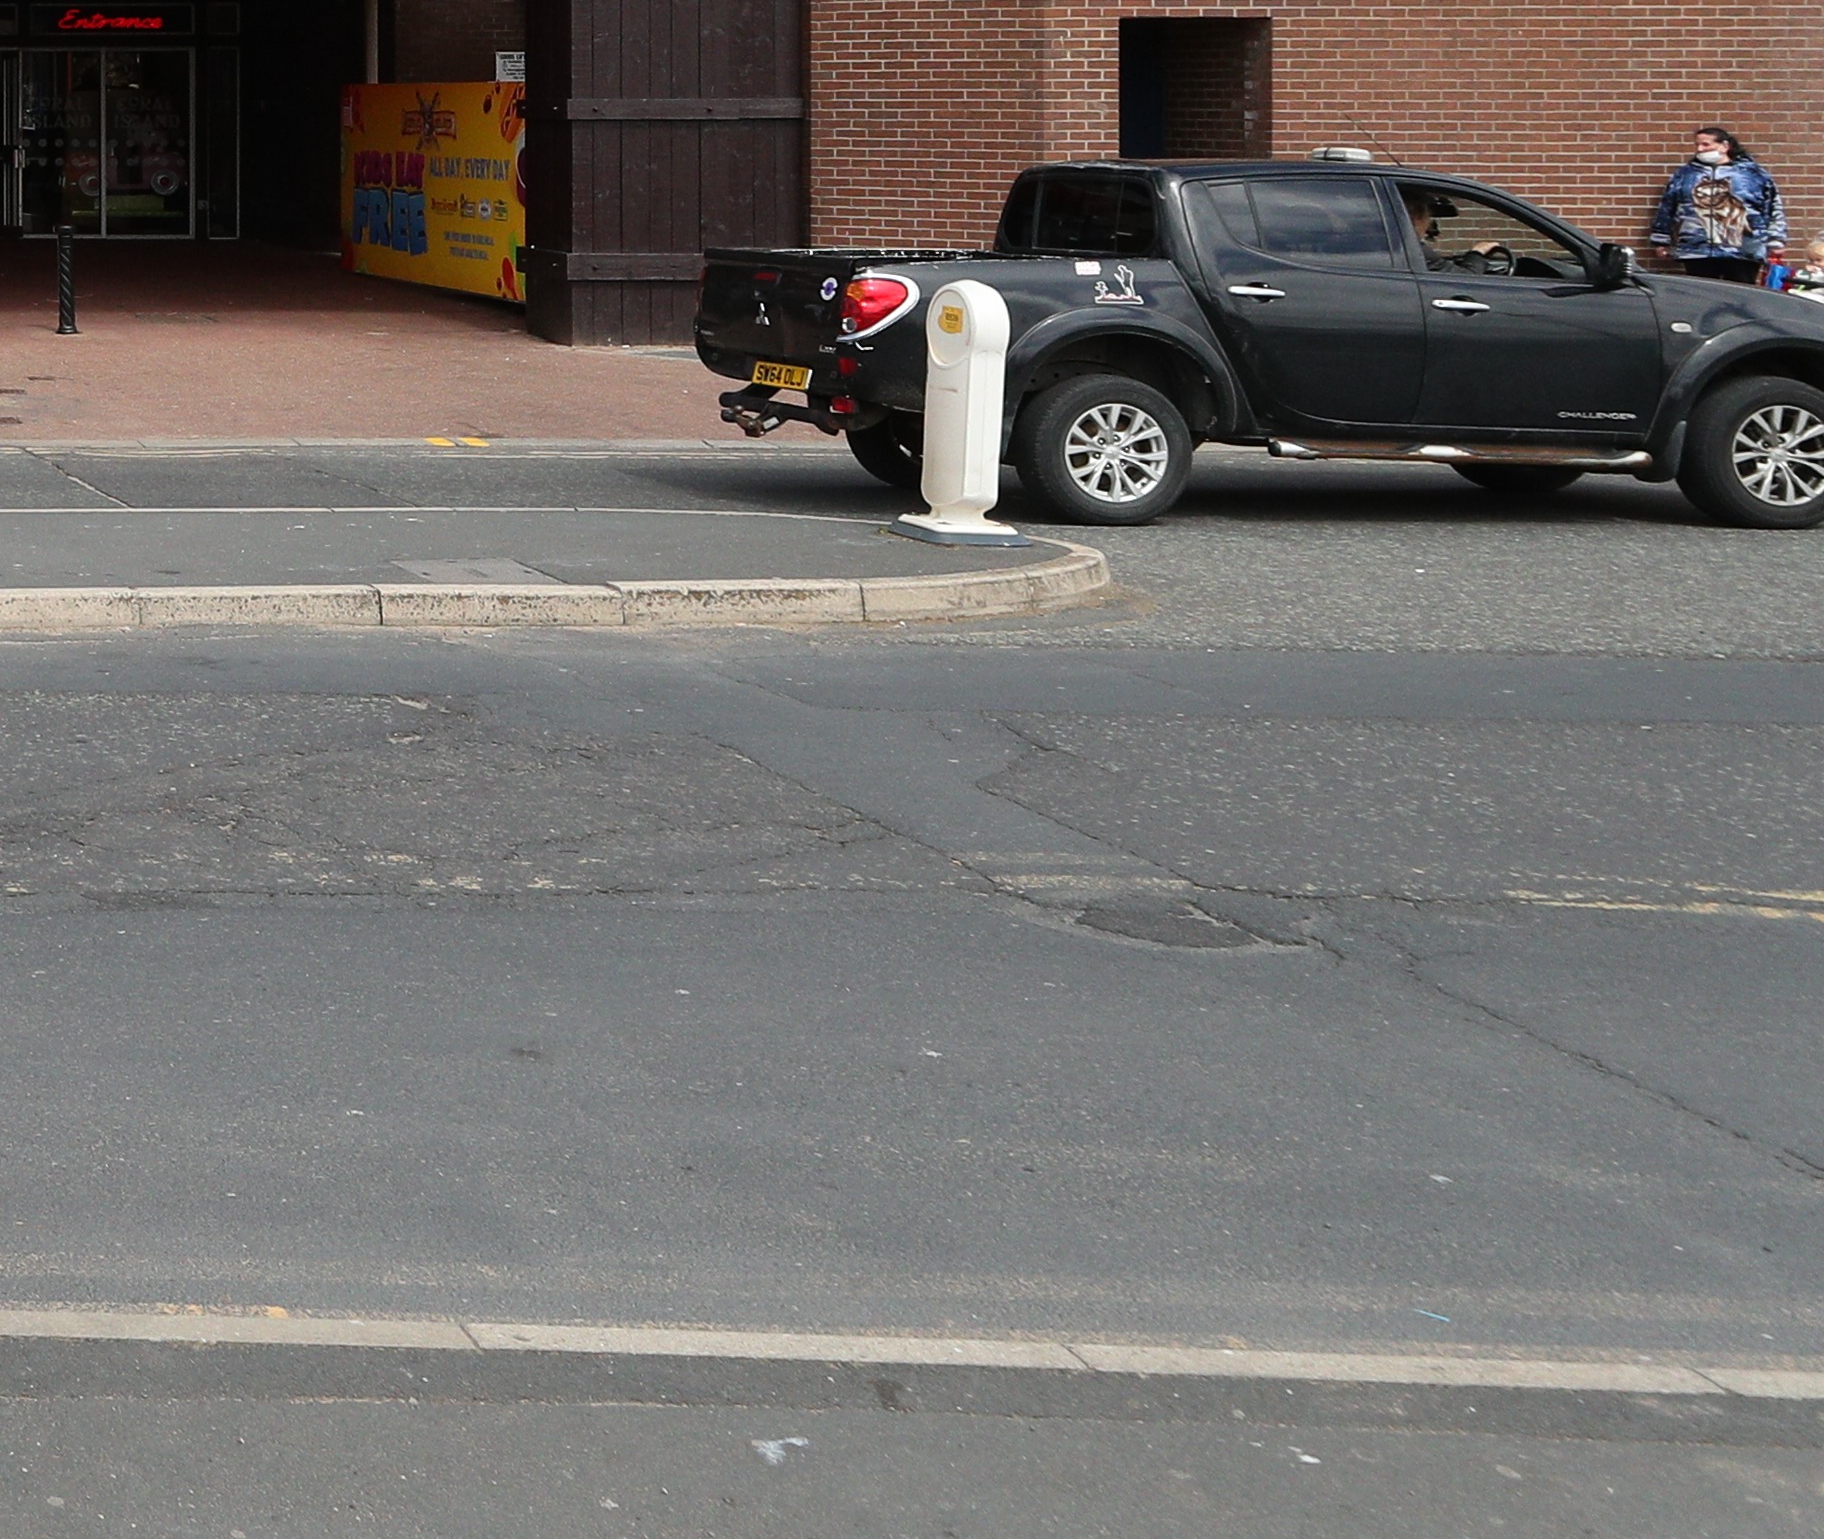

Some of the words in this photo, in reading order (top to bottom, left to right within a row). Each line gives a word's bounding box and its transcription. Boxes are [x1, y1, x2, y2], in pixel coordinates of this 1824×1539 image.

[58, 8, 163, 30] Entrance
[429, 157, 443, 178] ALL
[464, 158, 491, 181] EVERY
[492, 160, 511, 182] DAY
[353, 187, 429, 257] FREE
